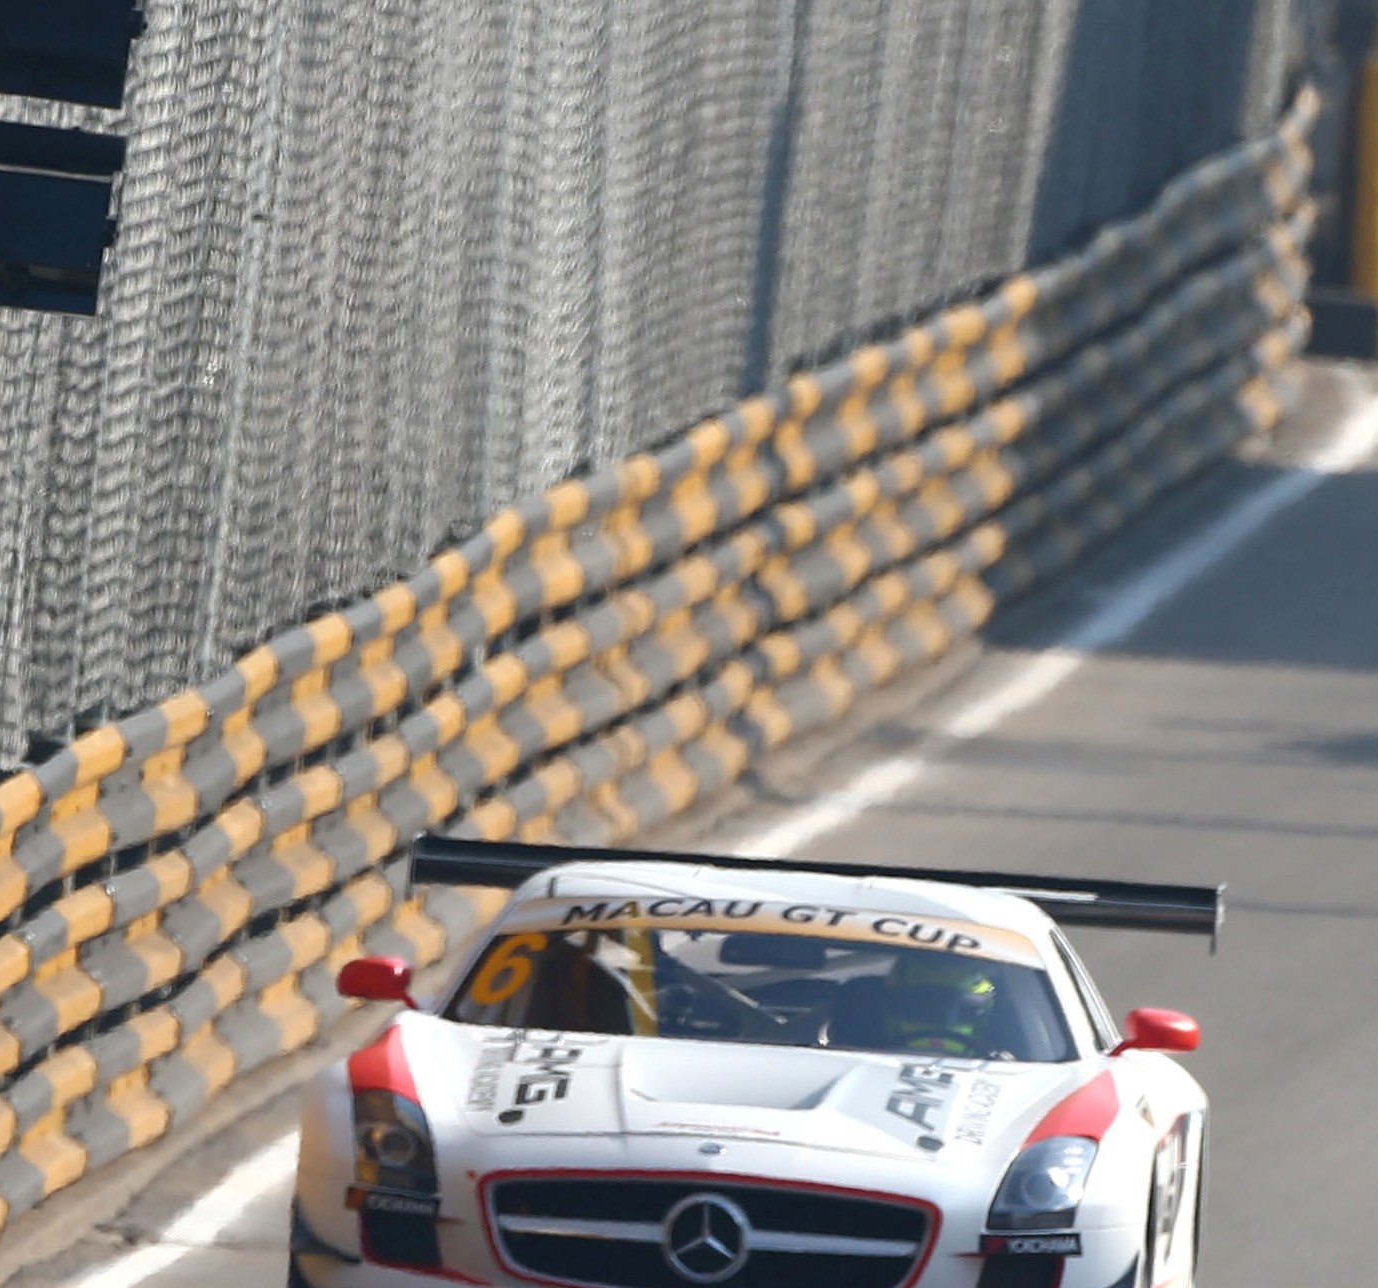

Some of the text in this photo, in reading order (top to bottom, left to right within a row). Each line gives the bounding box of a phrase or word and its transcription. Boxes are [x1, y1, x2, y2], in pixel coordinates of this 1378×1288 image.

[562, 901, 981, 950] MACAU GT CUP
[471, 932, 548, 1007] 6
